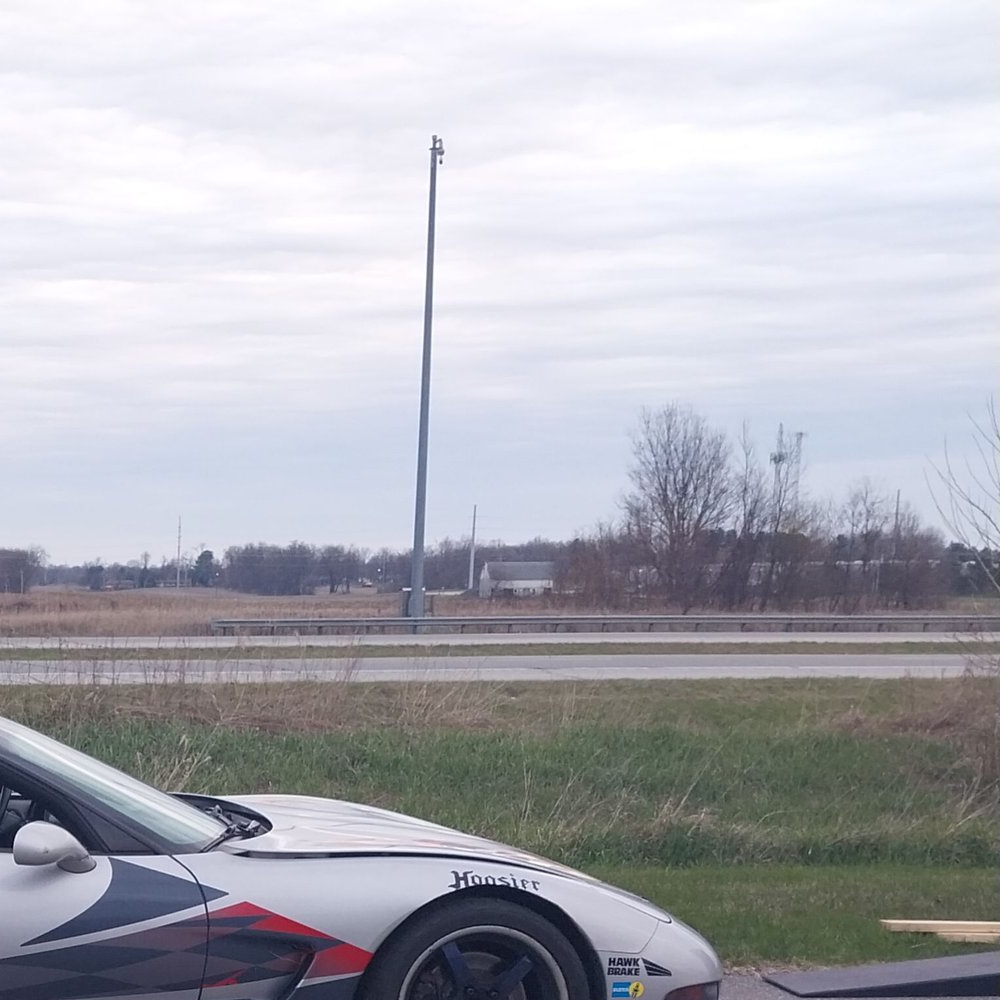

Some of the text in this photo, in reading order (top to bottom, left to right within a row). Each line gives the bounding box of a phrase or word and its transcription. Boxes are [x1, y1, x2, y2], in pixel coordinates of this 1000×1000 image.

[448, 870, 540, 891] Hoosier
[608, 957, 641, 967] HAWK
[607, 967, 640, 976] BRAKE
